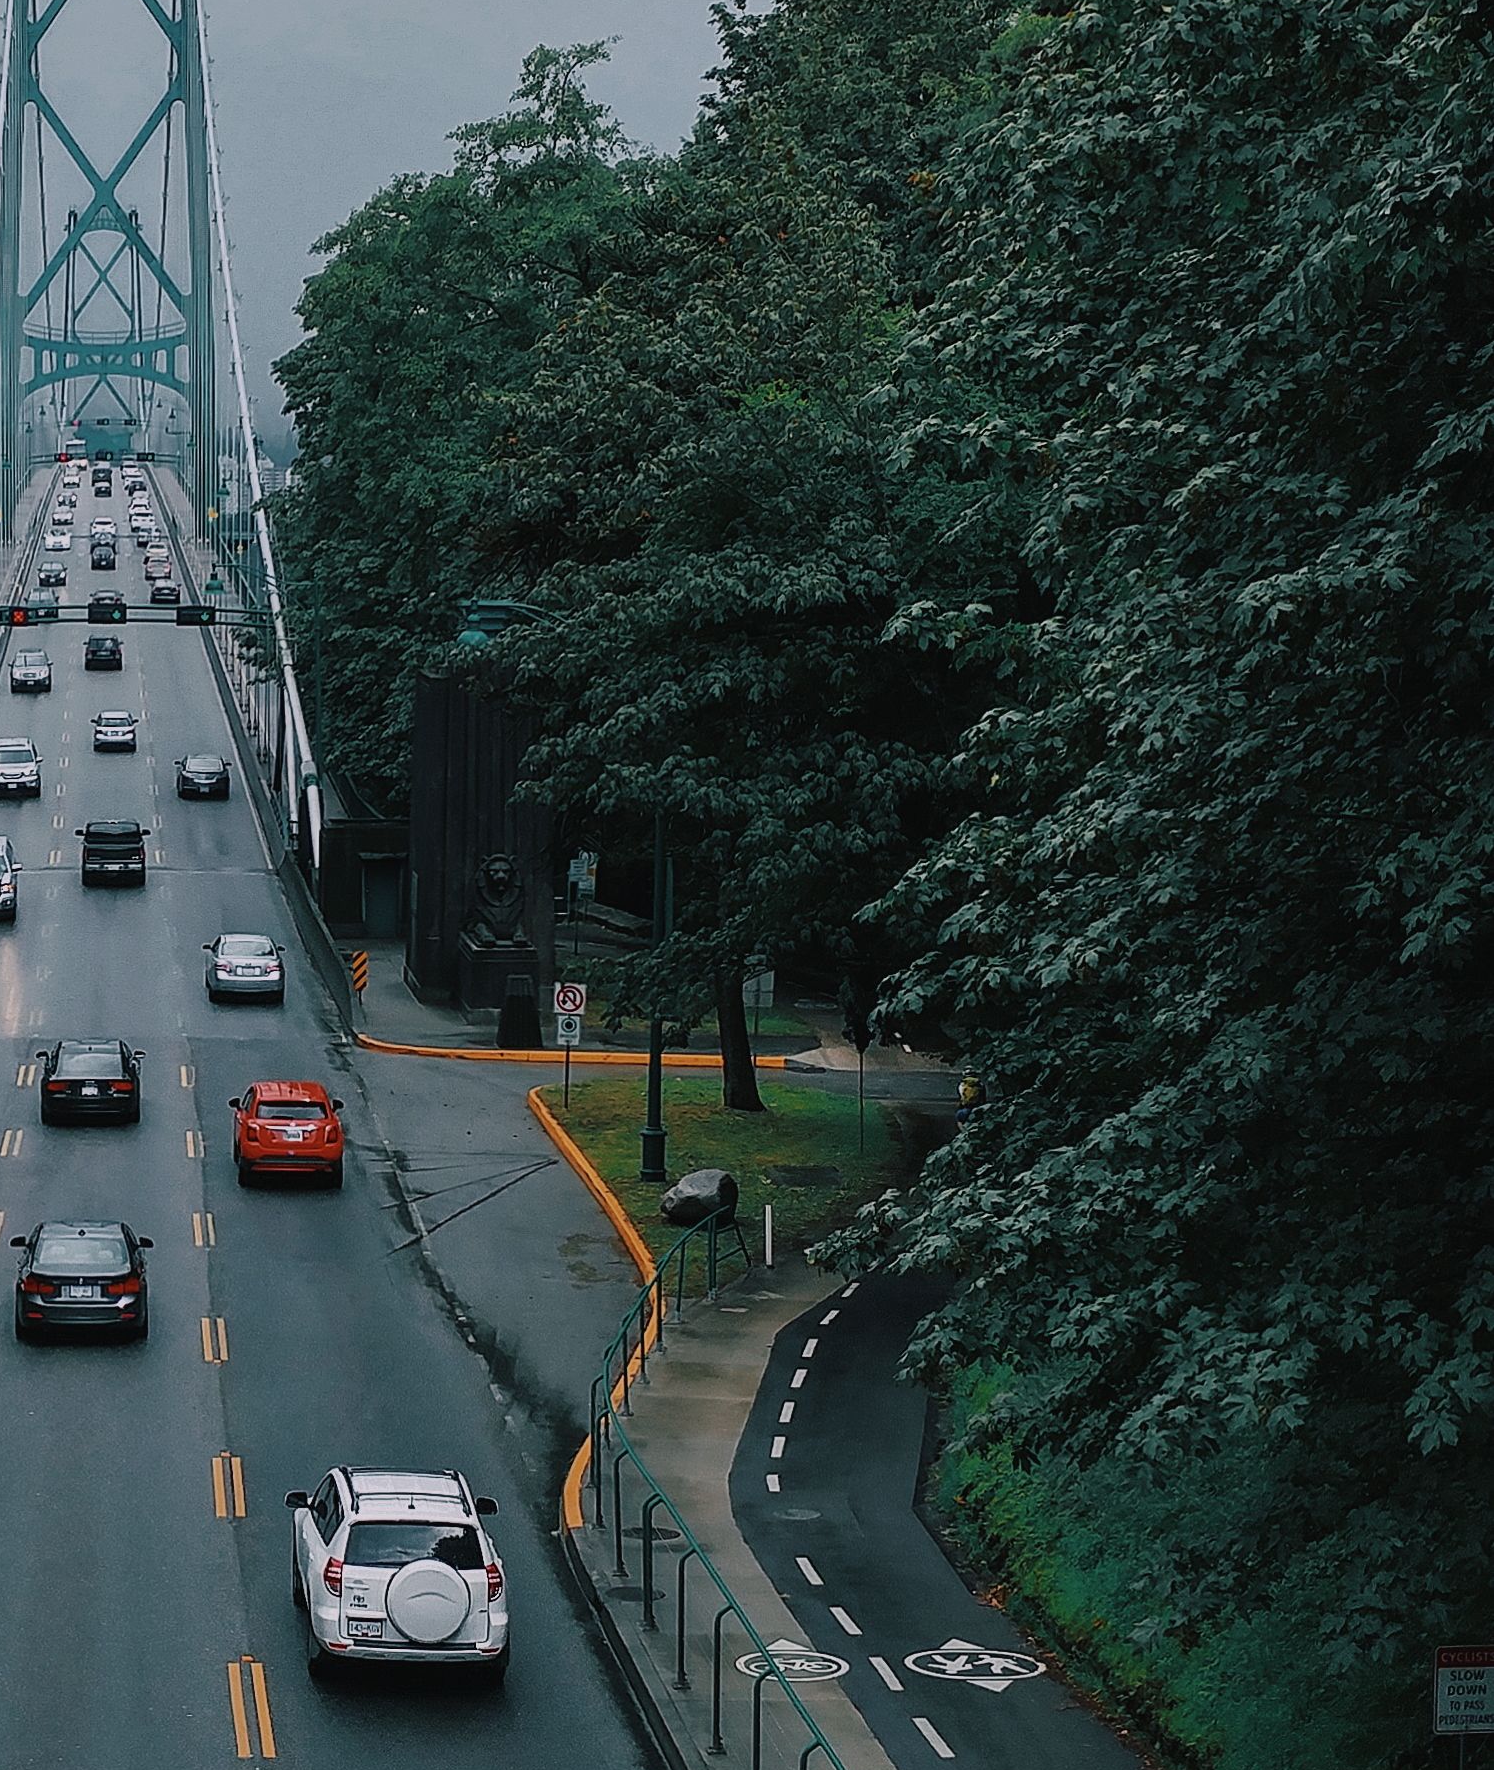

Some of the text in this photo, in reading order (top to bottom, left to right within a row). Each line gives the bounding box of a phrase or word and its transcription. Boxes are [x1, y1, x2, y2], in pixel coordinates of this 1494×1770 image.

[1440, 1650, 1494, 1663] CYCLISTS
[1449, 1669, 1486, 1682] SLOW
[1447, 1684, 1487, 1696] DOWN
[1449, 1700, 1485, 1711] TO PASS
[1438, 1714, 1494, 1726] PEDESTRIANS
